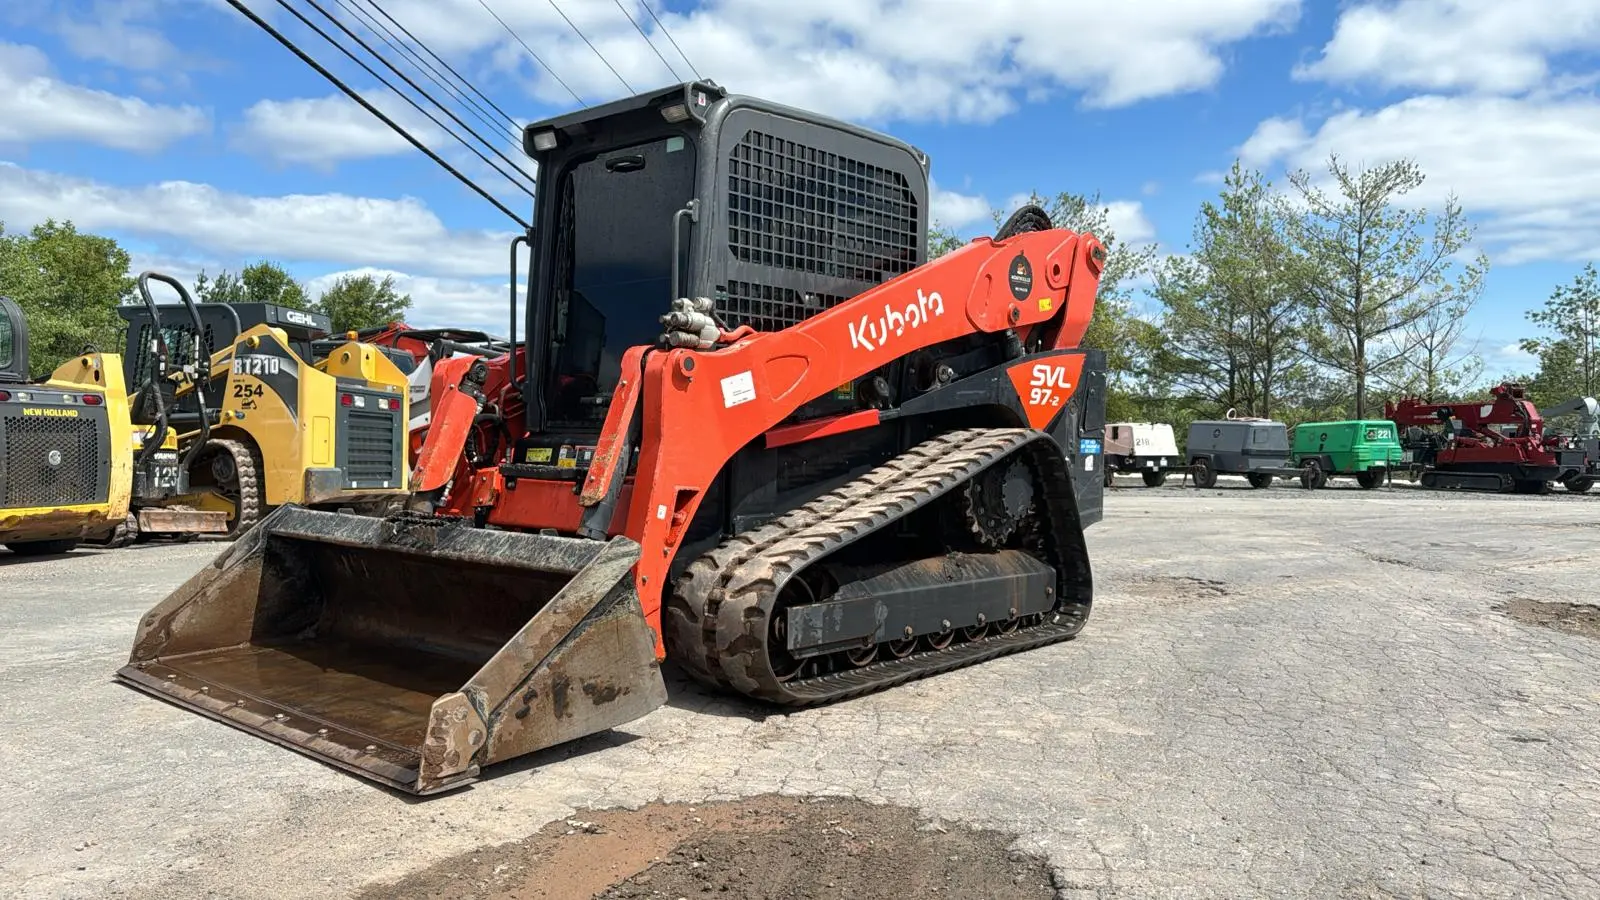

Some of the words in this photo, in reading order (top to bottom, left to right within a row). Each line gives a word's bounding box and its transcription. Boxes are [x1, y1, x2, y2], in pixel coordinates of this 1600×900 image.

[286, 311, 317, 327] GEHL
[848, 288, 944, 352] Kubota
[234, 357, 280, 375] RT210
[1030, 364, 1071, 389] SVL
[233, 384, 264, 398] 254
[1029, 388, 1060, 407] 97-2
[23, 408, 42, 416] NEW
[43, 409, 79, 418] HOLLAND
[1377, 430, 1391, 439] 221
